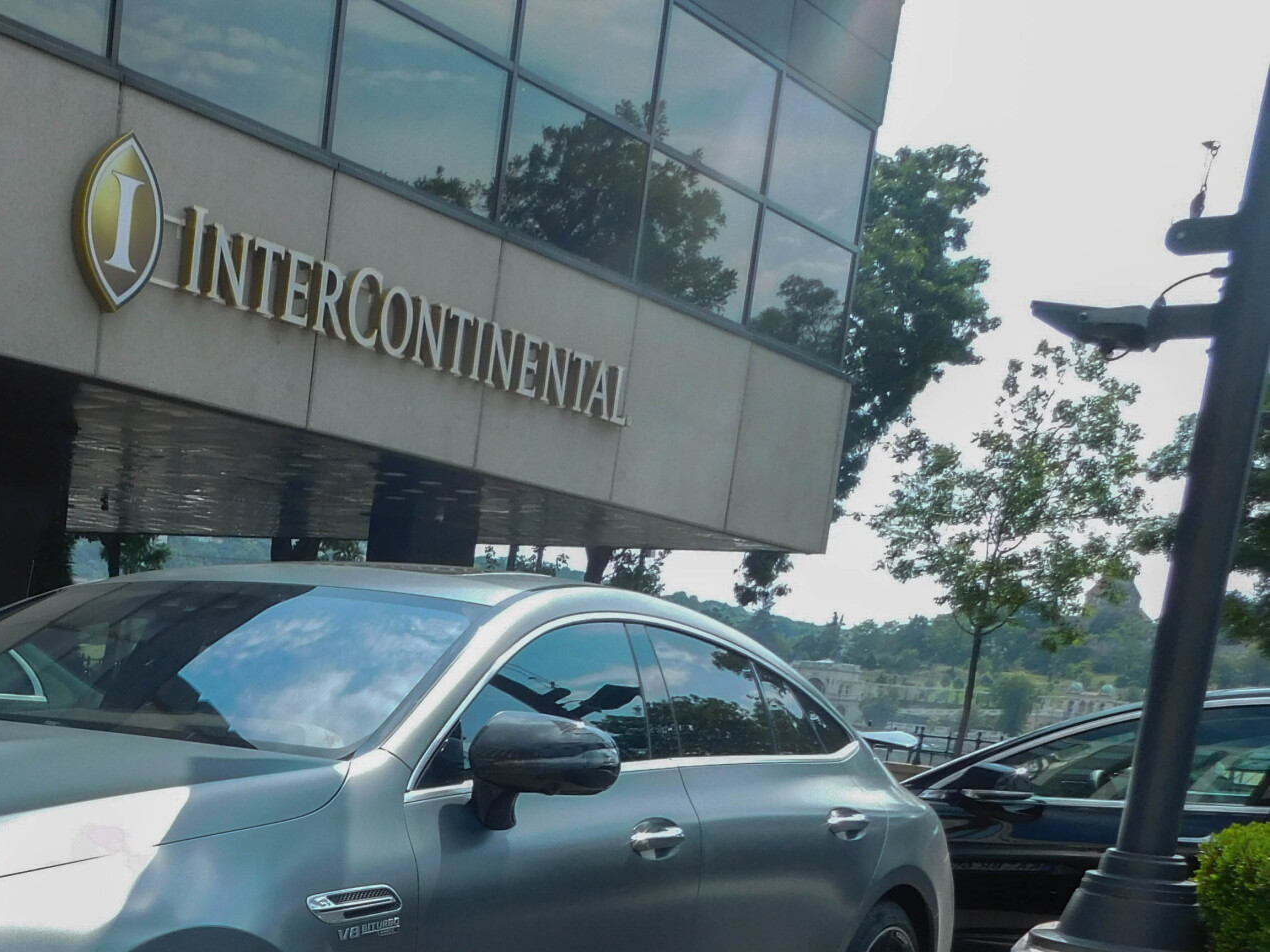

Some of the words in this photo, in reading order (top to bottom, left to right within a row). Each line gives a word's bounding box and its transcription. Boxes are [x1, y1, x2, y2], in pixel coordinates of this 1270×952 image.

[178, 204, 628, 426] INTERCONTINENTAL
[337, 925, 361, 942] V8
[361, 916, 400, 933] BITURBO
